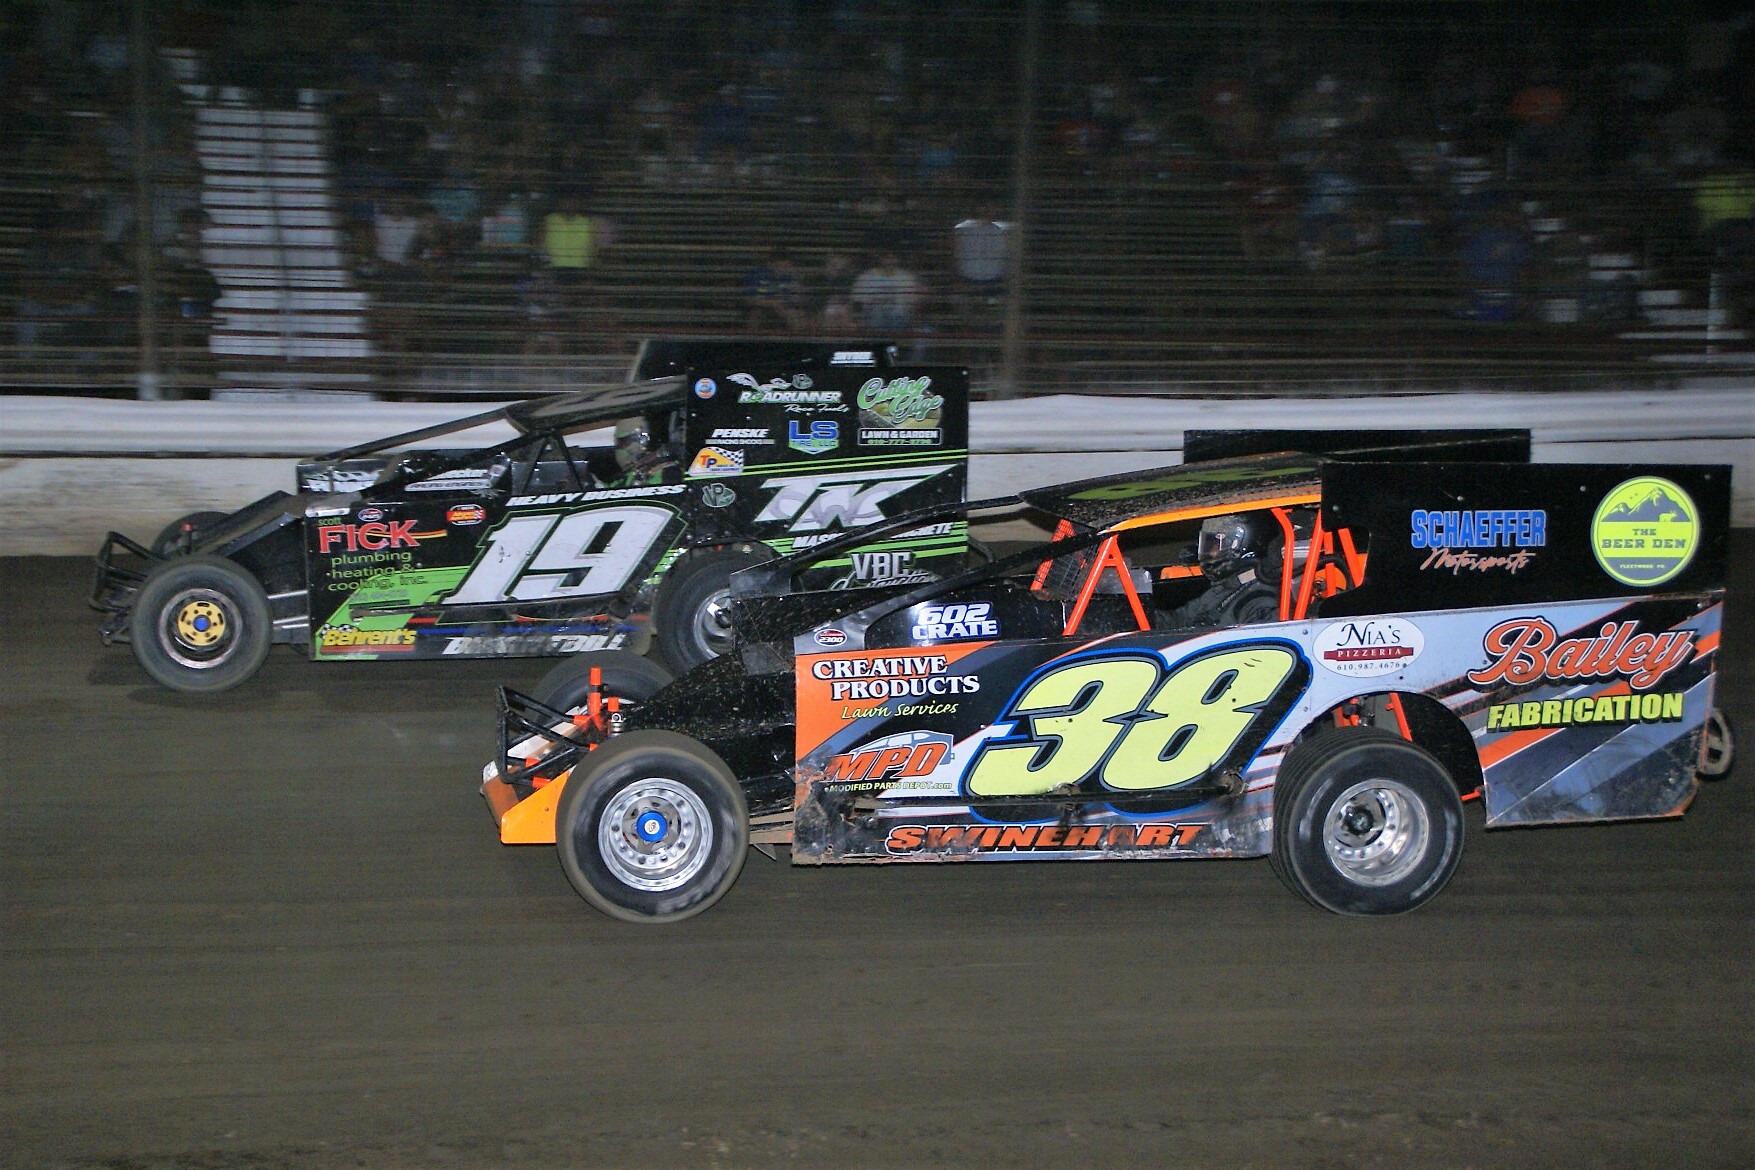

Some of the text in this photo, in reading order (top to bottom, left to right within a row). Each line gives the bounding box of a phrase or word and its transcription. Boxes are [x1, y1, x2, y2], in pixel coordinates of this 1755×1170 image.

[739, 391, 841, 403] ROADRUNNER
[857, 376, 931, 409] Cutting
[784, 403, 849, 412] Race Fuels
[889, 394, 944, 423] Edge
[712, 429, 769, 438] PENSKE
[788, 420, 839, 440] LS
[861, 431, 938, 439] LAWN & GARDEN
[700, 454, 717, 468] TP
[505, 484, 687, 506] HEAVY BUSINESS
[754, 463, 958, 532] TK
[318, 519, 421, 553] FICK
[1411, 509, 1547, 549] SCHAEFFER
[1632, 528, 1657, 536] THE
[438, 504, 676, 605] 19
[1602, 539, 1687, 549] BEER DEN
[331, 551, 412, 567] plumbing
[851, 552, 912, 580] VBC
[1419, 548, 1537, 575] Motorsports
[332, 563, 415, 580] heating &
[917, 603, 992, 625] 602
[323, 628, 418, 646] Behrent's
[912, 619, 999, 640] CRATE
[1337, 648, 1402, 658] PIZZERIA
[1467, 616, 1698, 691] Bailey
[812, 655, 949, 680] CREATIVE
[1336, 661, 1400, 671] 610.987.4676
[831, 675, 981, 701] PRODUCTS
[841, 700, 960, 719] Lawn Services
[1486, 692, 1685, 730] FABRICATION
[968, 648, 1298, 797] 38
[824, 742, 949, 781] MPD
[829, 780, 953, 792] MODIFIED PARTS DEPOT.com
[886, 824, 1206, 850] SWINEHART
